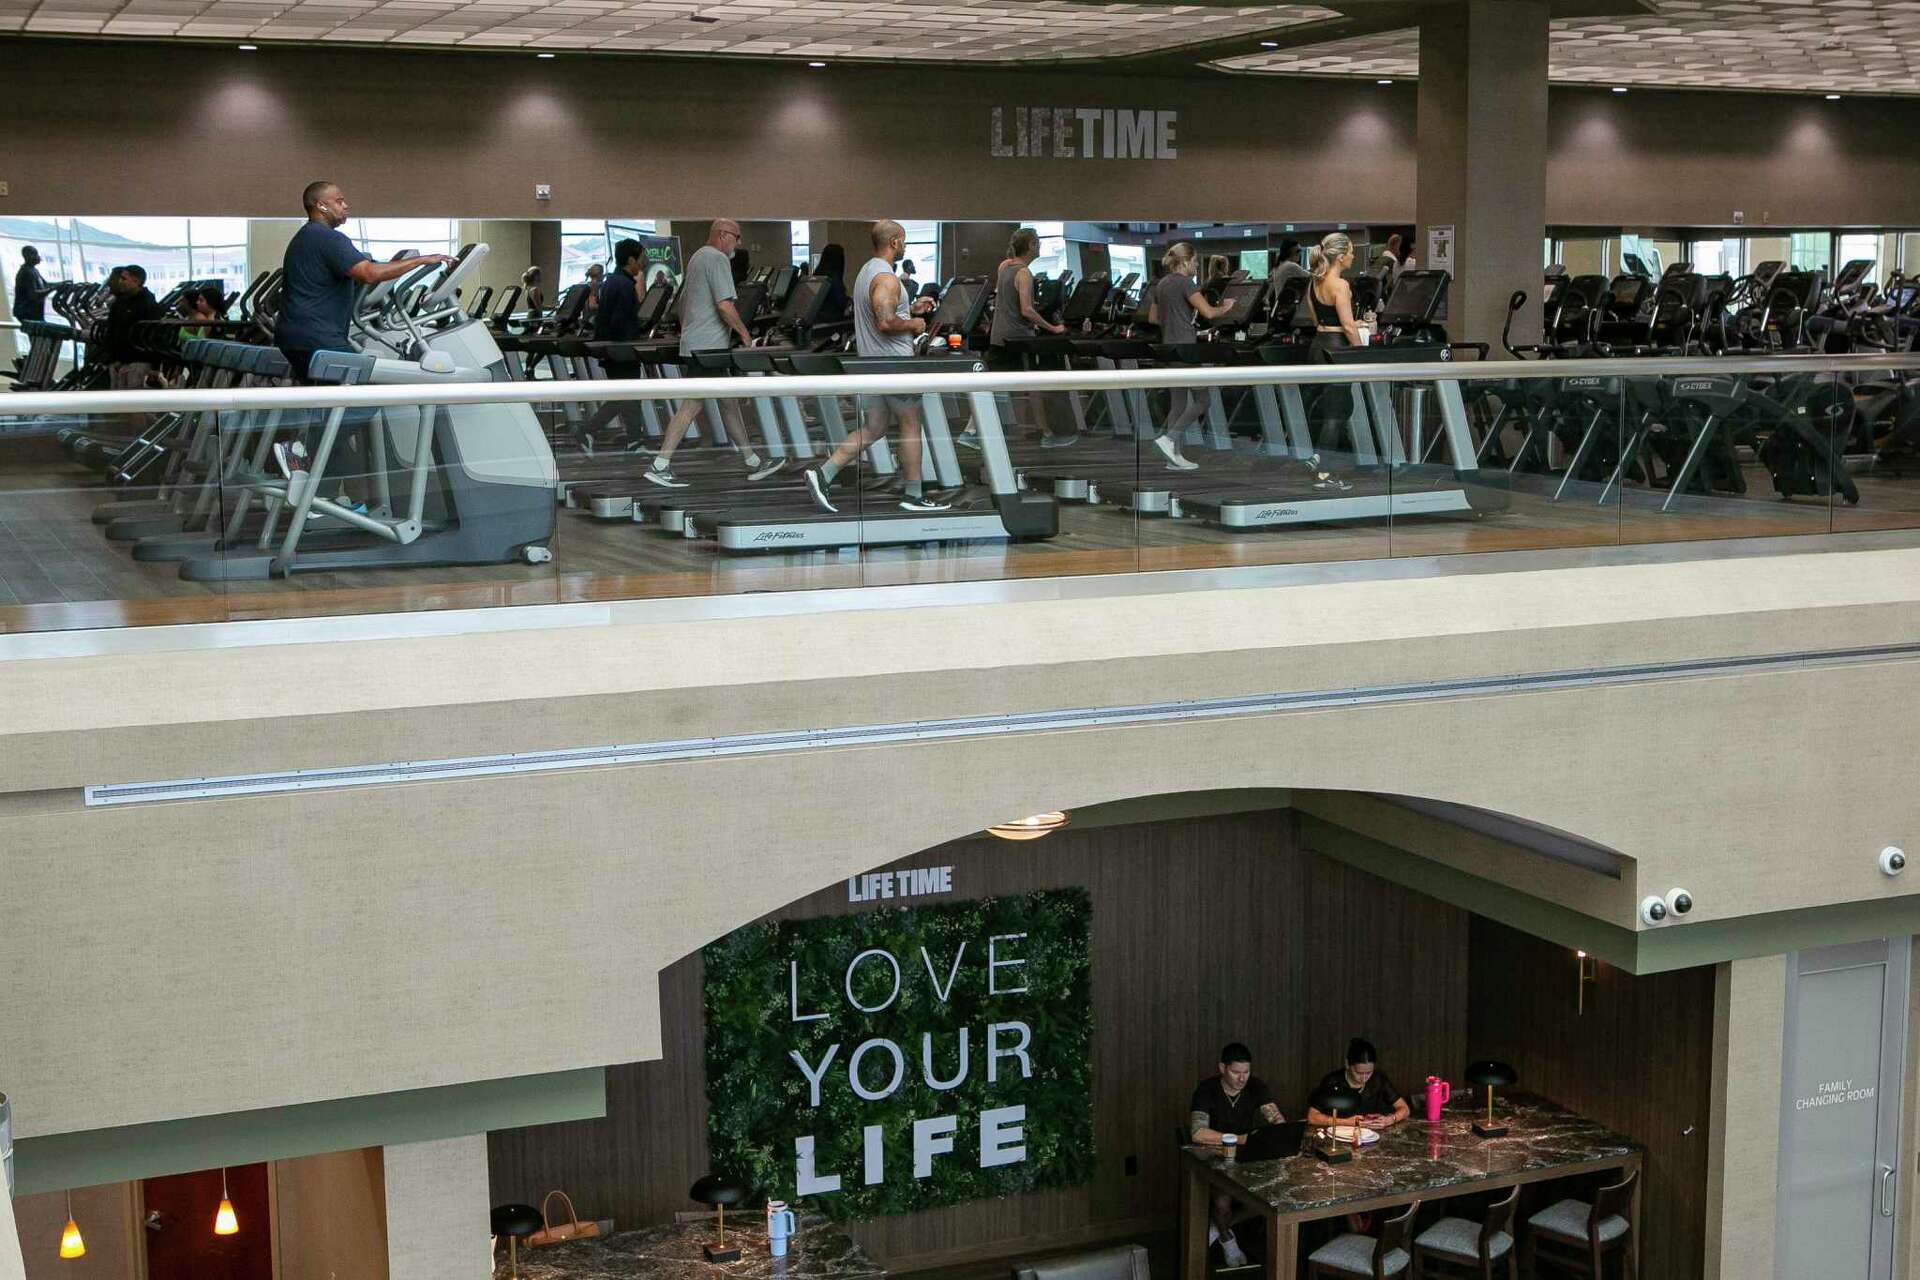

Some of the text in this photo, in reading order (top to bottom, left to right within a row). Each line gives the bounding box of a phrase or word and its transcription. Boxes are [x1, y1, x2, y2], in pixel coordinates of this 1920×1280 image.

[791, 933, 1028, 1021] LOVE
[789, 1021, 1032, 1107] YOUR
[1796, 1088, 1874, 1110] CHANGING ROOM
[1819, 1080, 1852, 1093] FAMILY
[795, 1104, 1027, 1196] LIFE
